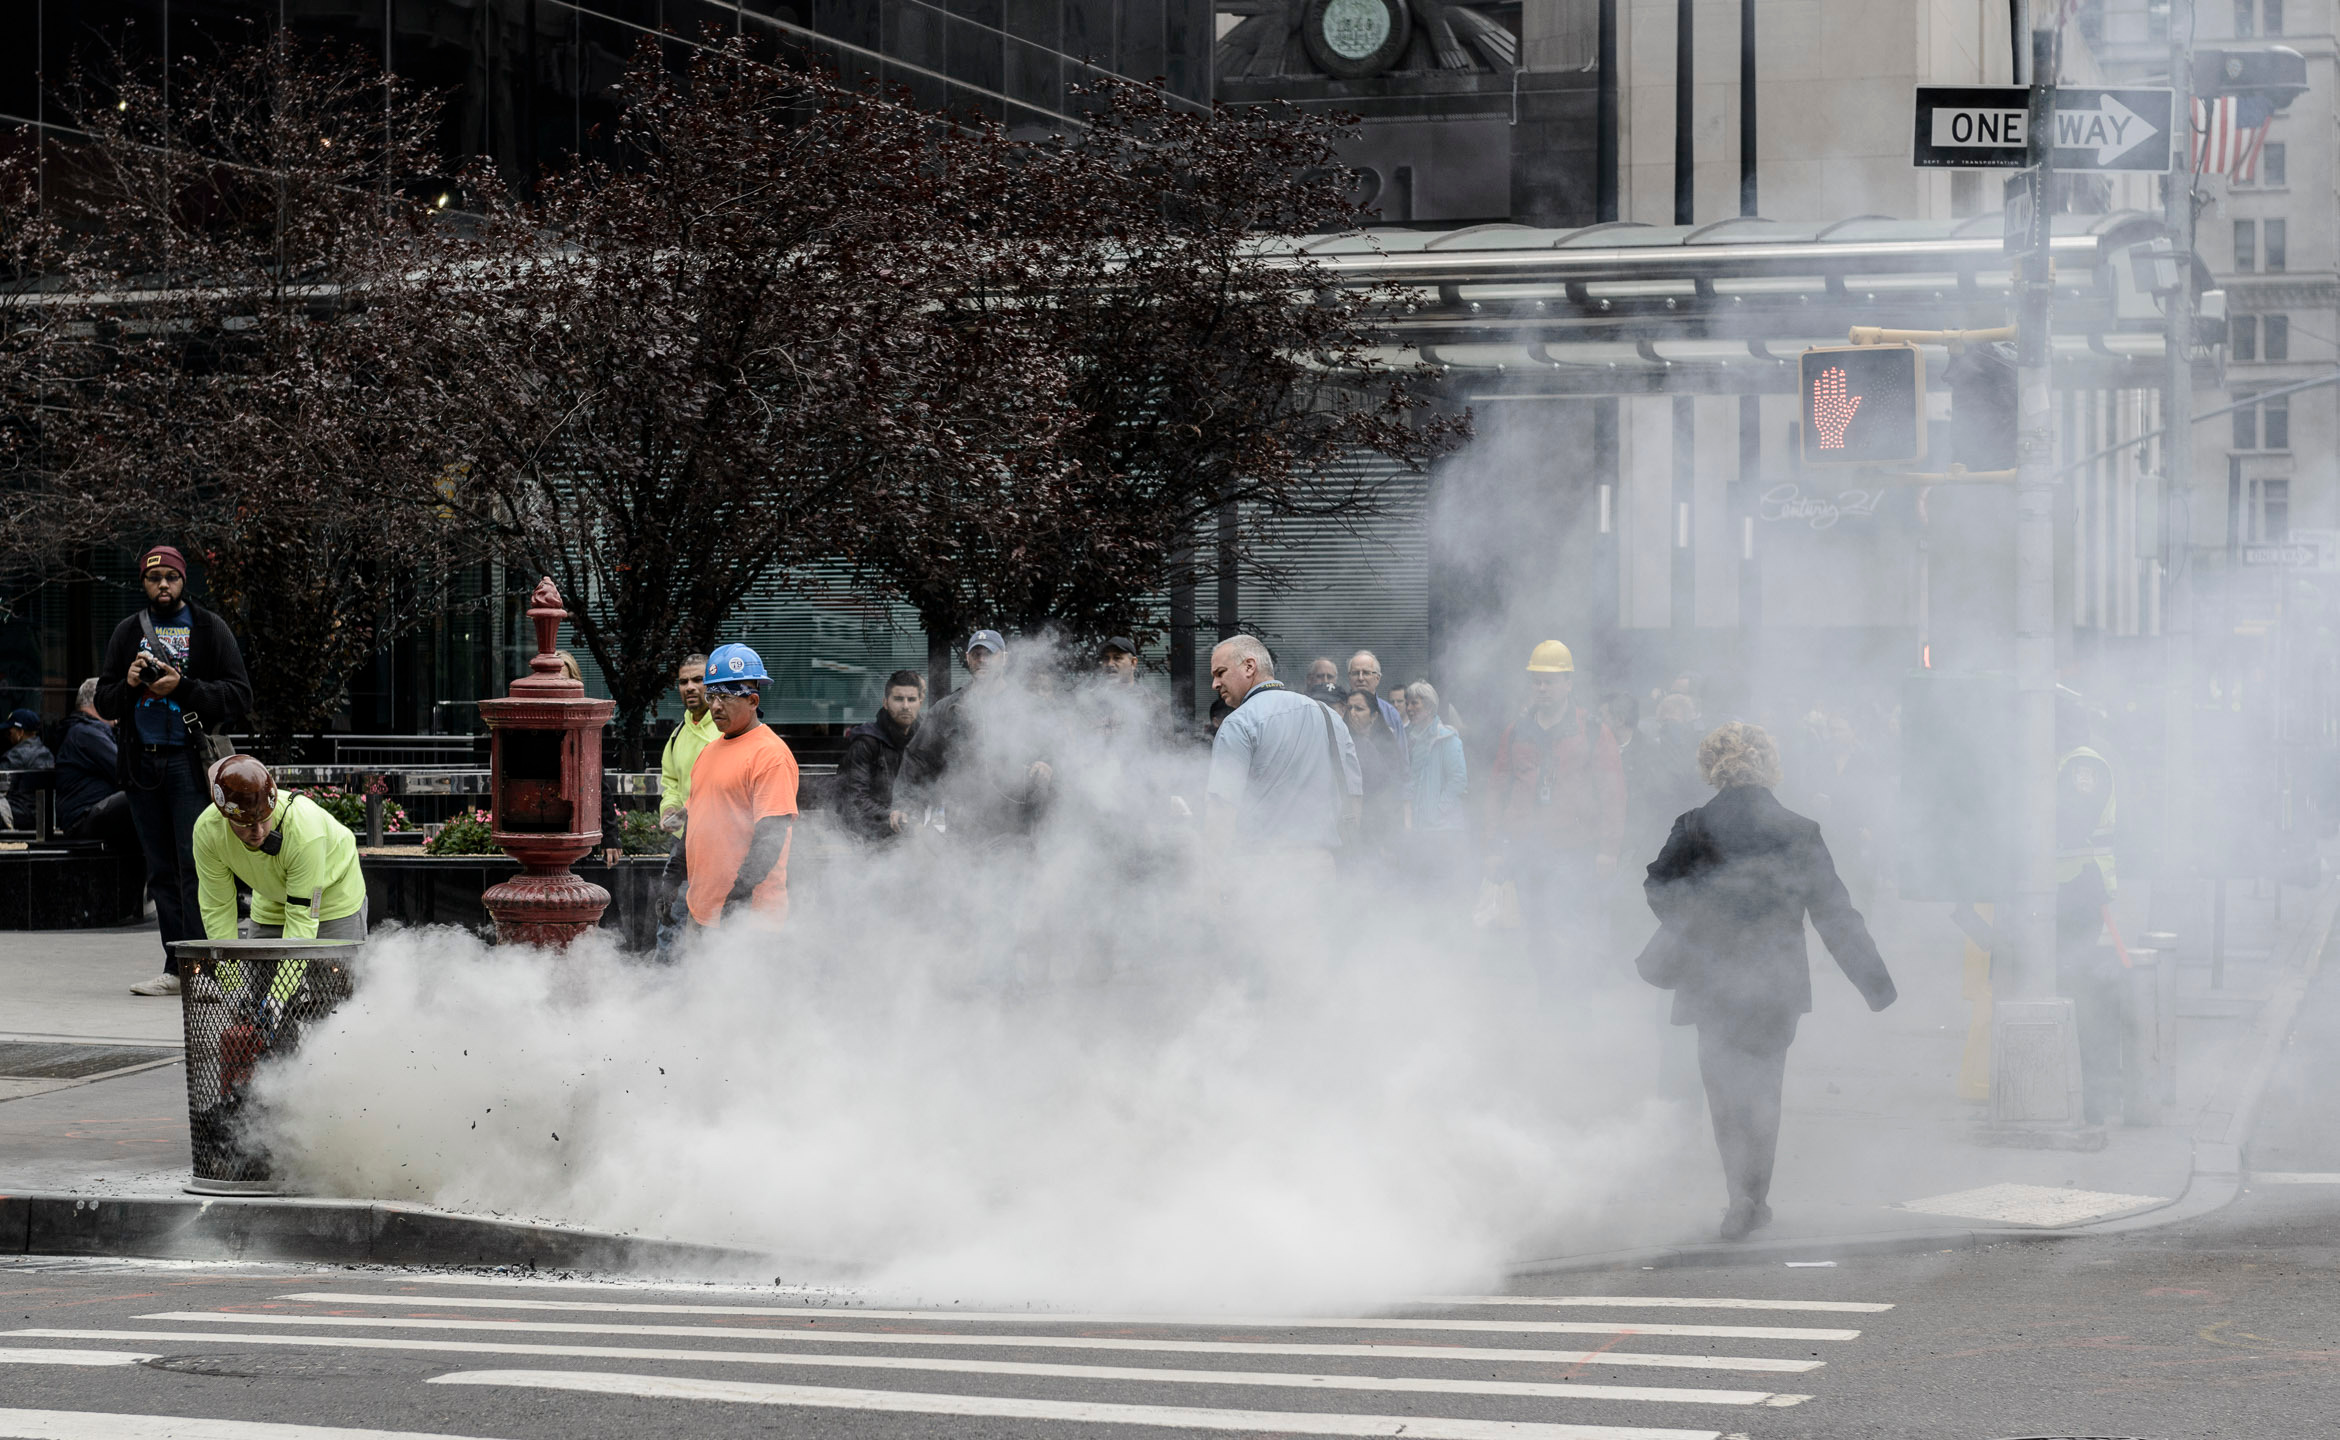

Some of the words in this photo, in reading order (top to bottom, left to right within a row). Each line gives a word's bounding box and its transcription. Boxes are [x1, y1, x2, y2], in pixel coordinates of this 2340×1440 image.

[1951, 112, 2022, 143] ONE
[2057, 114, 2133, 146] WAY
[1760, 483, 1839, 529] Century
[1838, 489, 1885, 516] 21
[155, 626, 190, 636] MAZING
